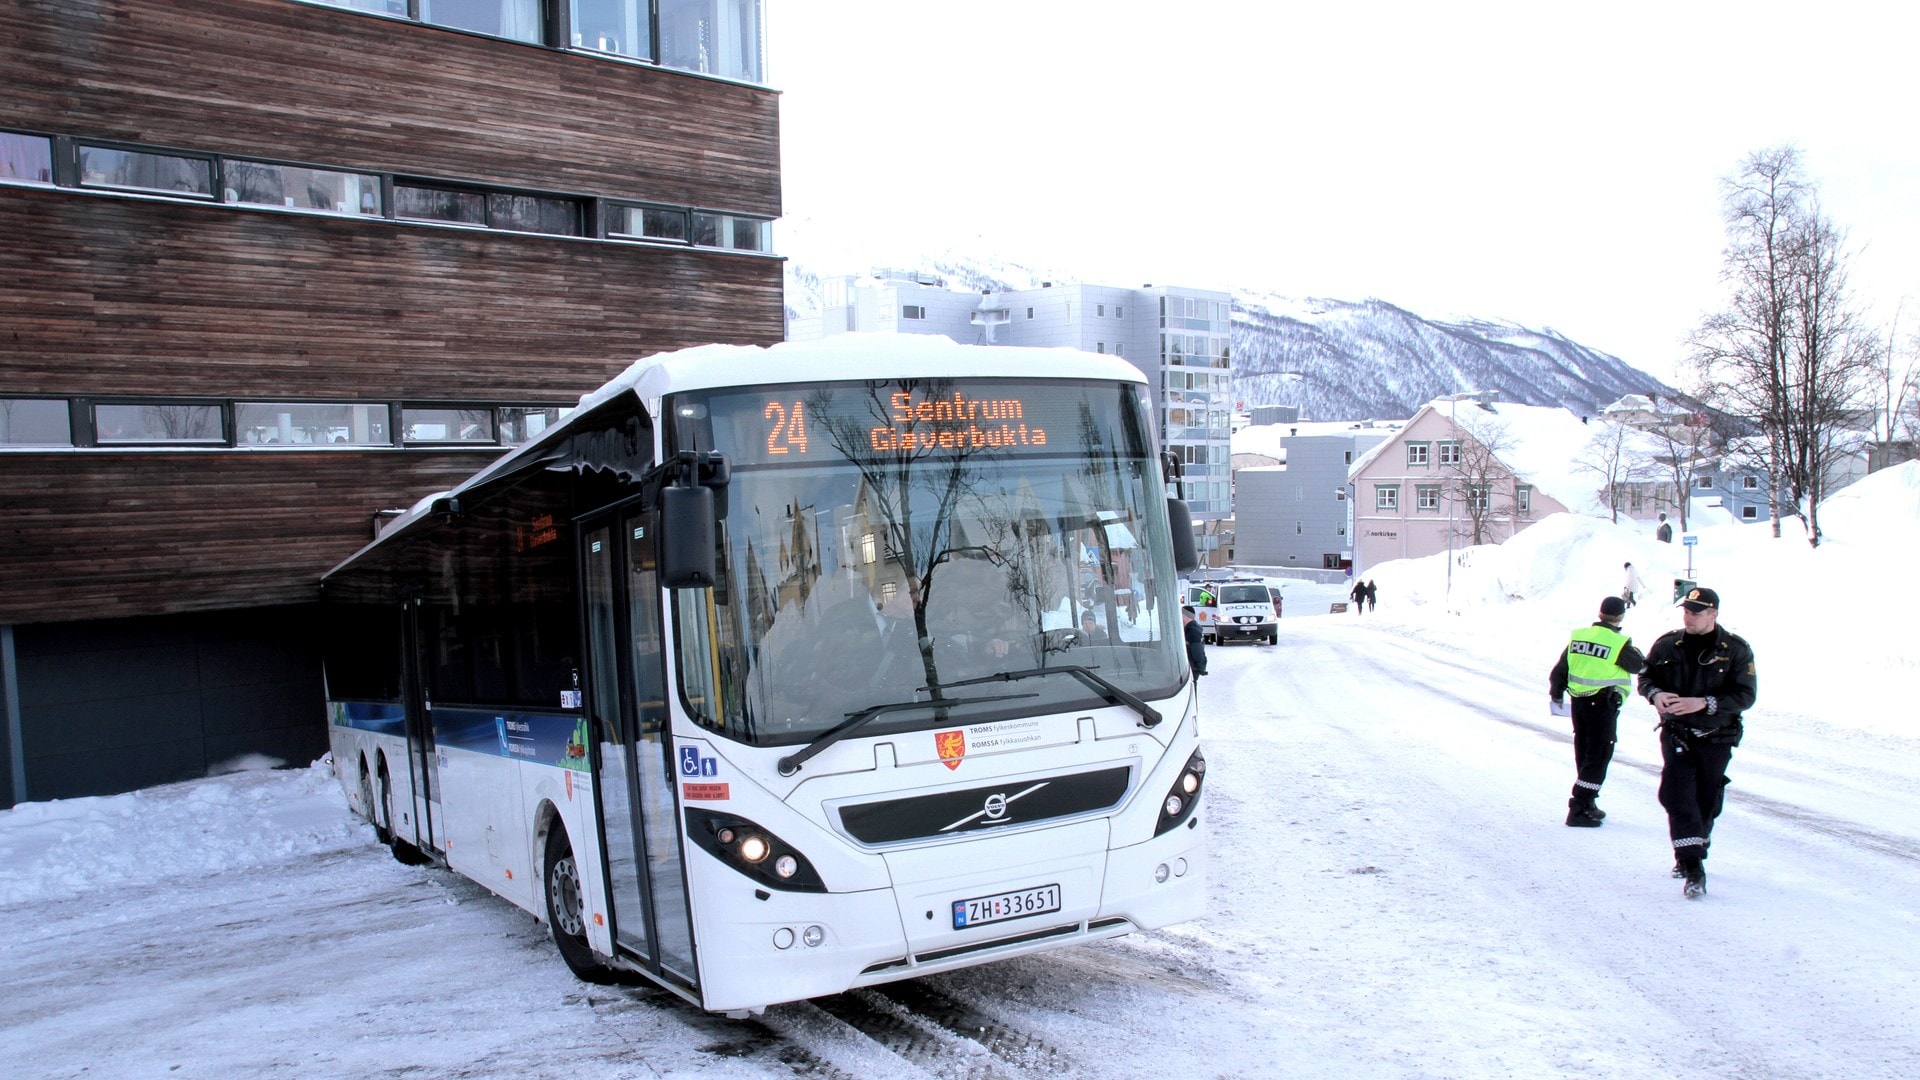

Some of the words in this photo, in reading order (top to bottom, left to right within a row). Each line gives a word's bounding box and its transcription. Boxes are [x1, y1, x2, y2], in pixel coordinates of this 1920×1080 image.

[890, 392, 1023, 421] Sentrum
[764, 401, 807, 454] 24
[1570, 640, 1610, 659] POLITI
[969, 725, 993, 735] TROMS
[993, 721, 1039, 732] fylkeskommune
[971, 740, 999, 749] ROMSSA
